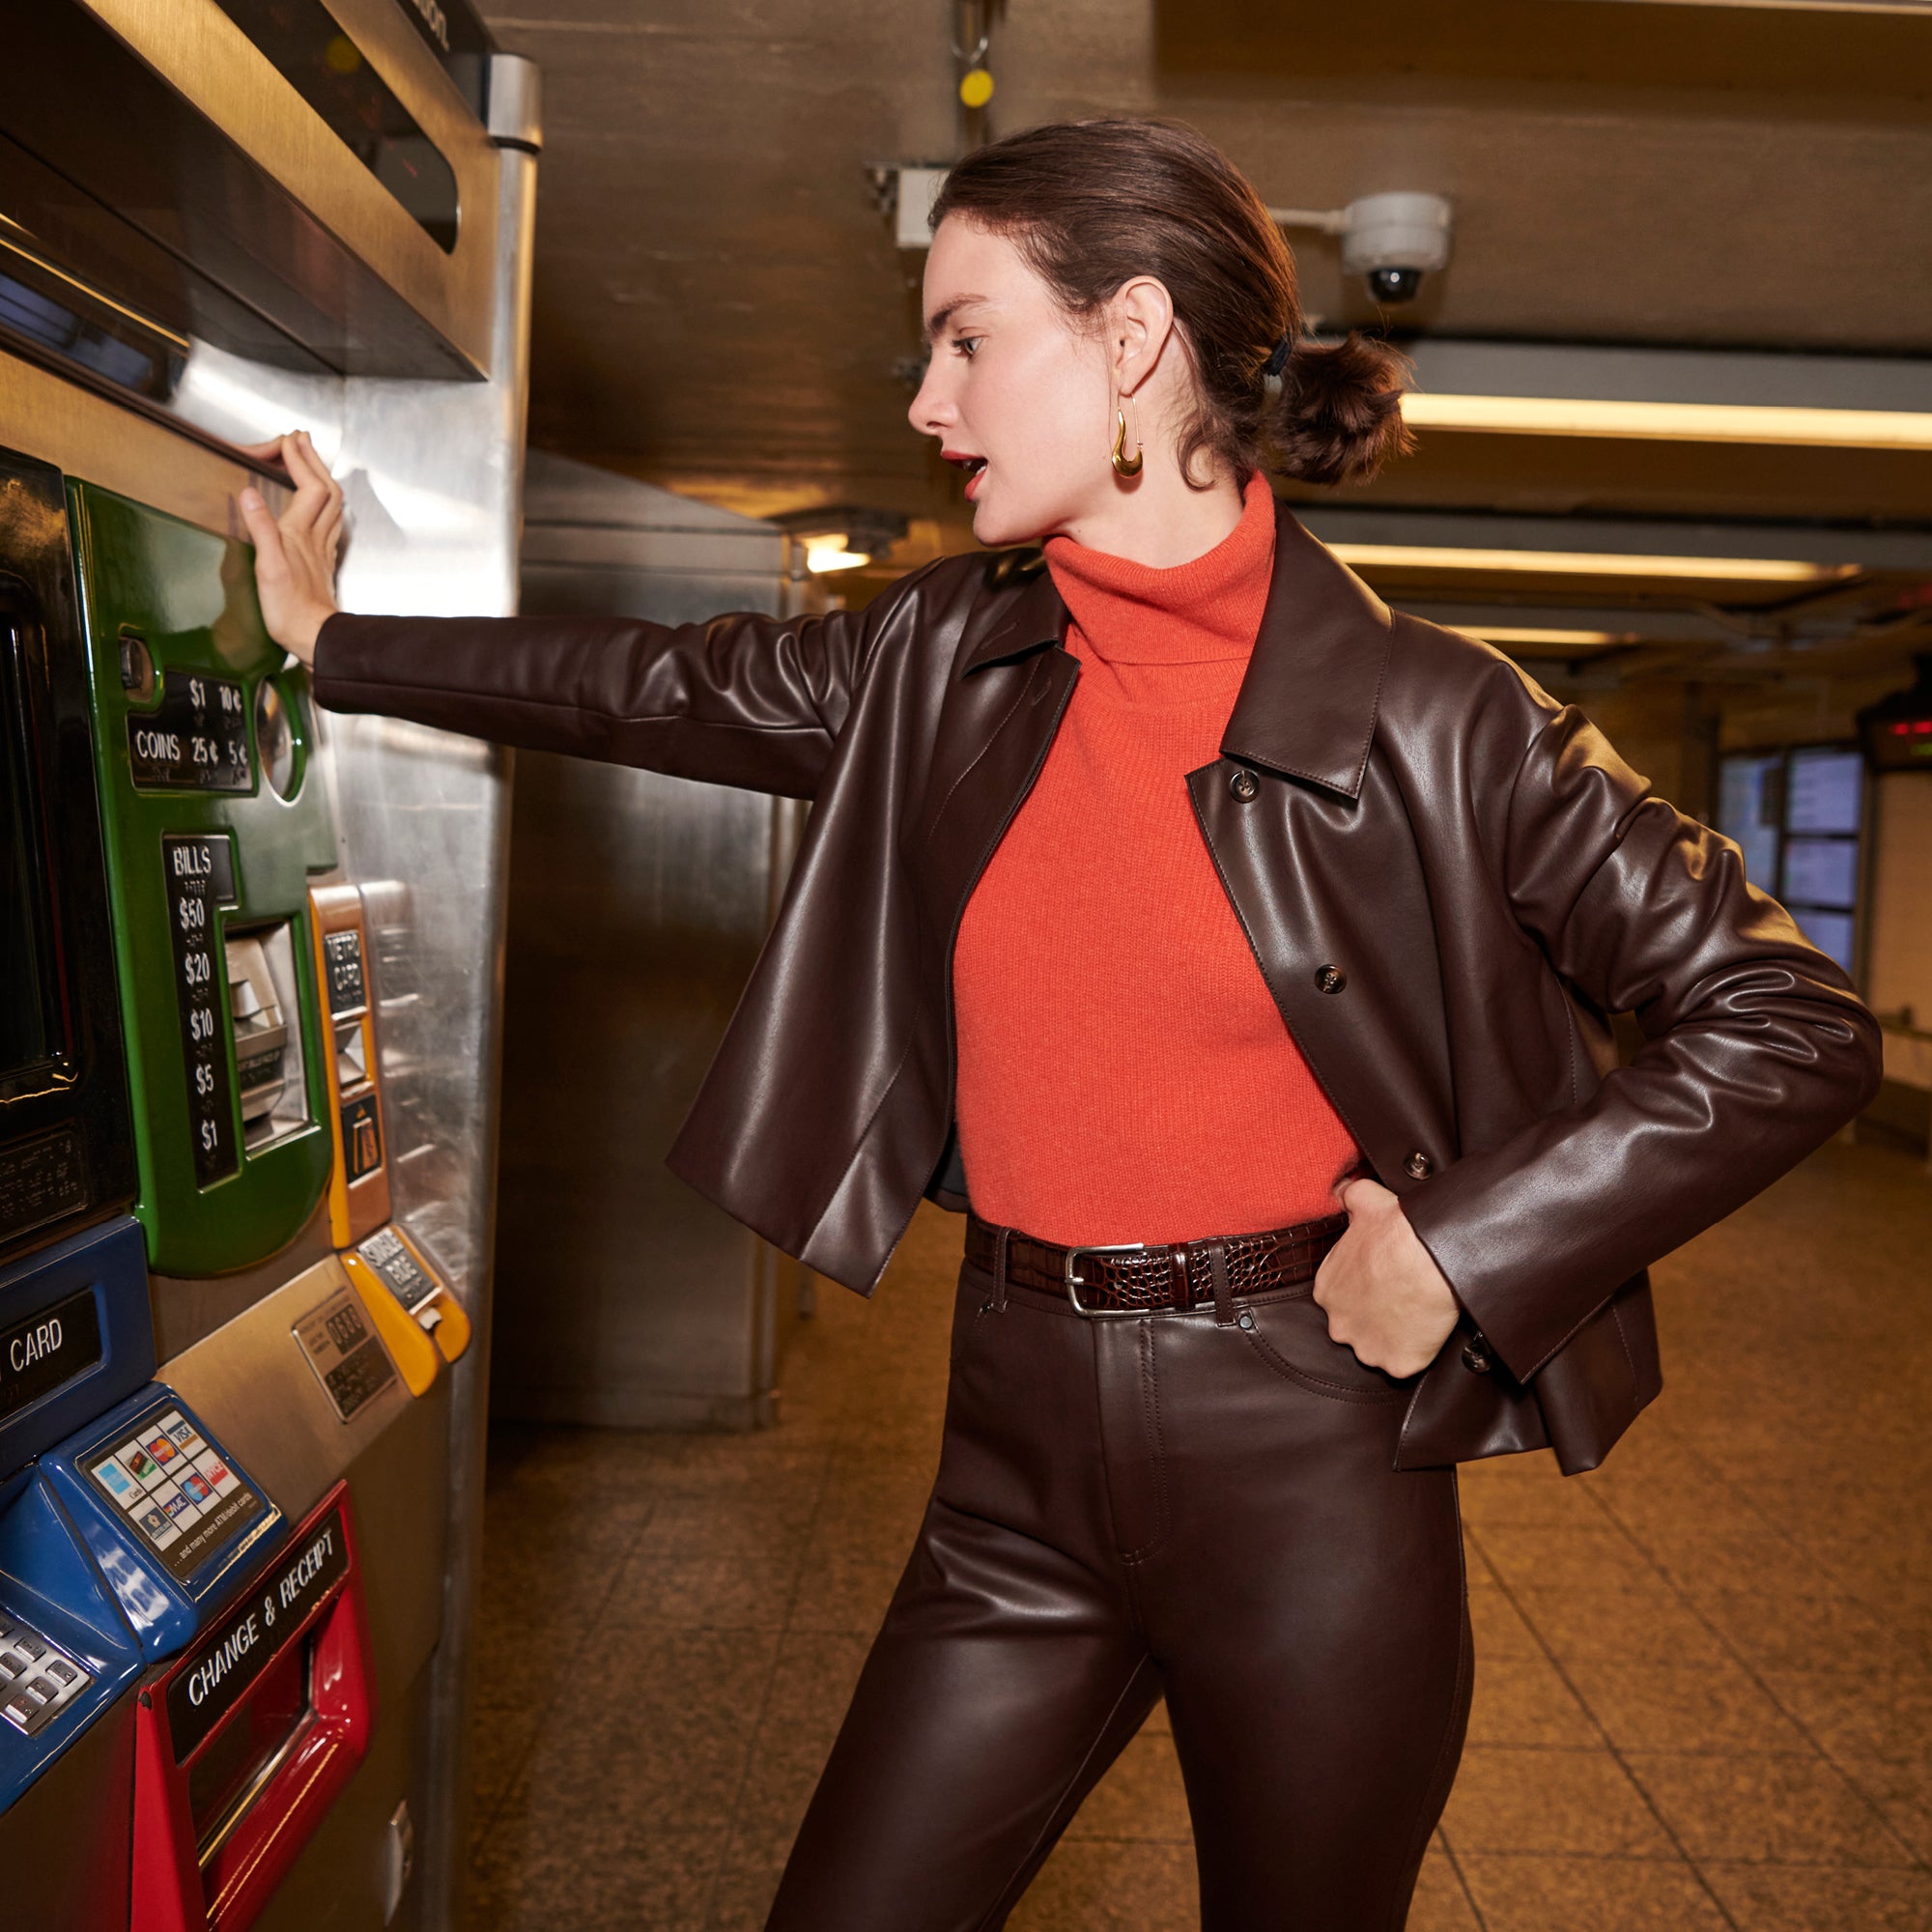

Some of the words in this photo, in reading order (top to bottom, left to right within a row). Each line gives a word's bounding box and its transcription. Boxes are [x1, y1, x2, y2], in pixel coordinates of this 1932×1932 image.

[189, 677, 206, 709] $1
[136, 729, 181, 761] COINS
[173, 845, 212, 876] BILLS
[180, 896, 205, 932] $50
[185, 952, 211, 986] $20
[190, 1008, 213, 1042] $10
[195, 1064, 213, 1097] $5
[201, 1119, 218, 1151] $1
[10, 1319, 63, 1372] CARD
[173, 1426, 193, 1443] VISA
[168, 1495, 188, 1518] MAC
[188, 1534, 207, 1550] many
[202, 1522, 218, 1539] more
[213, 1501, 241, 1527] ATM/debit
[237, 1492, 253, 1507] cards
[188, 1612, 260, 1707] CHANGE
[264, 1595, 276, 1627] &
[278, 1527, 333, 1609] RECEIPT
